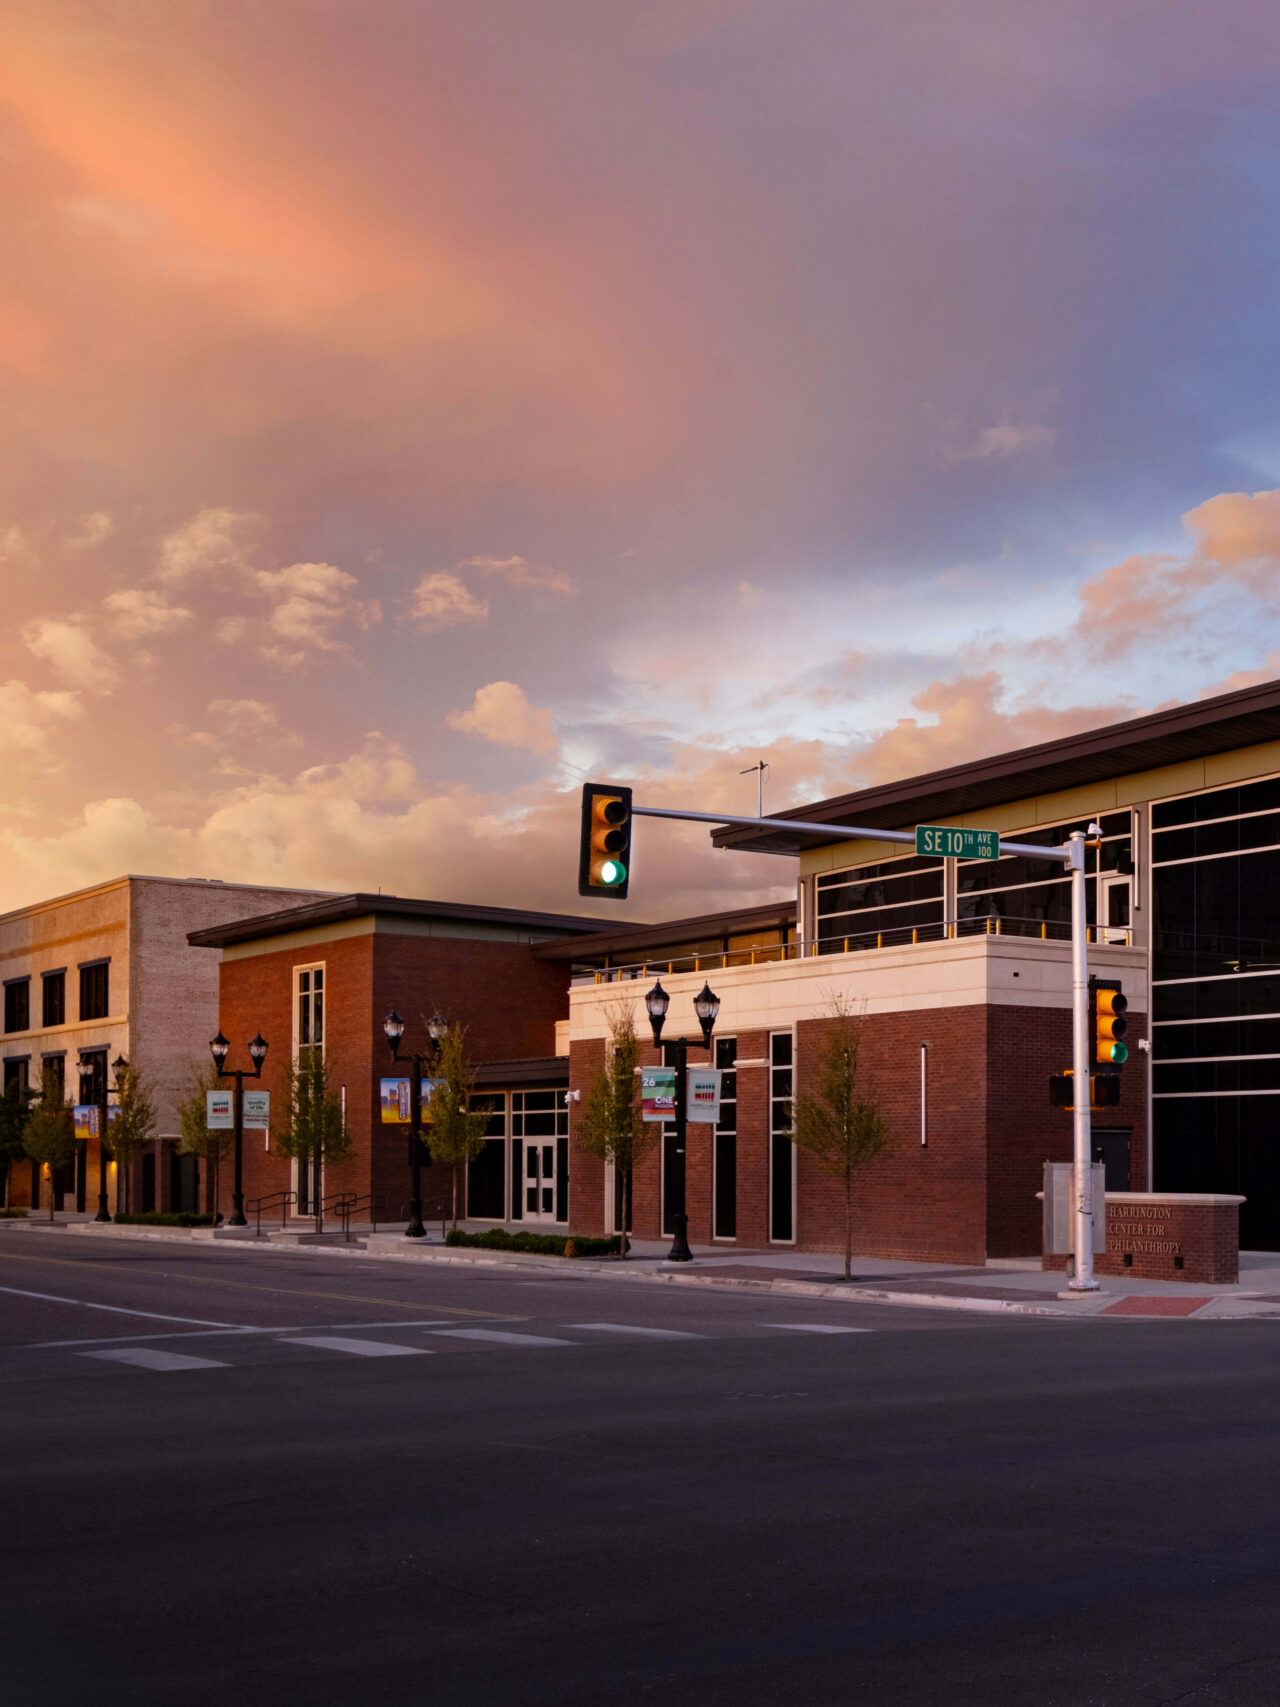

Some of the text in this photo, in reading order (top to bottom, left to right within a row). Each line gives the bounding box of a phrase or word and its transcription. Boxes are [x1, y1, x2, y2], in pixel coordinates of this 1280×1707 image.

[924, 830, 992, 853] SE 10TH AVE
[978, 846, 992, 857] 100
[642, 1077, 656, 1087] 26
[655, 1096, 674, 1104] ONE
[1110, 1206, 1172, 1219] HARRINGTON
[1110, 1223, 1165, 1236] CENTER FOR
[1110, 1239, 1181, 1254] PHILANTHROPY
